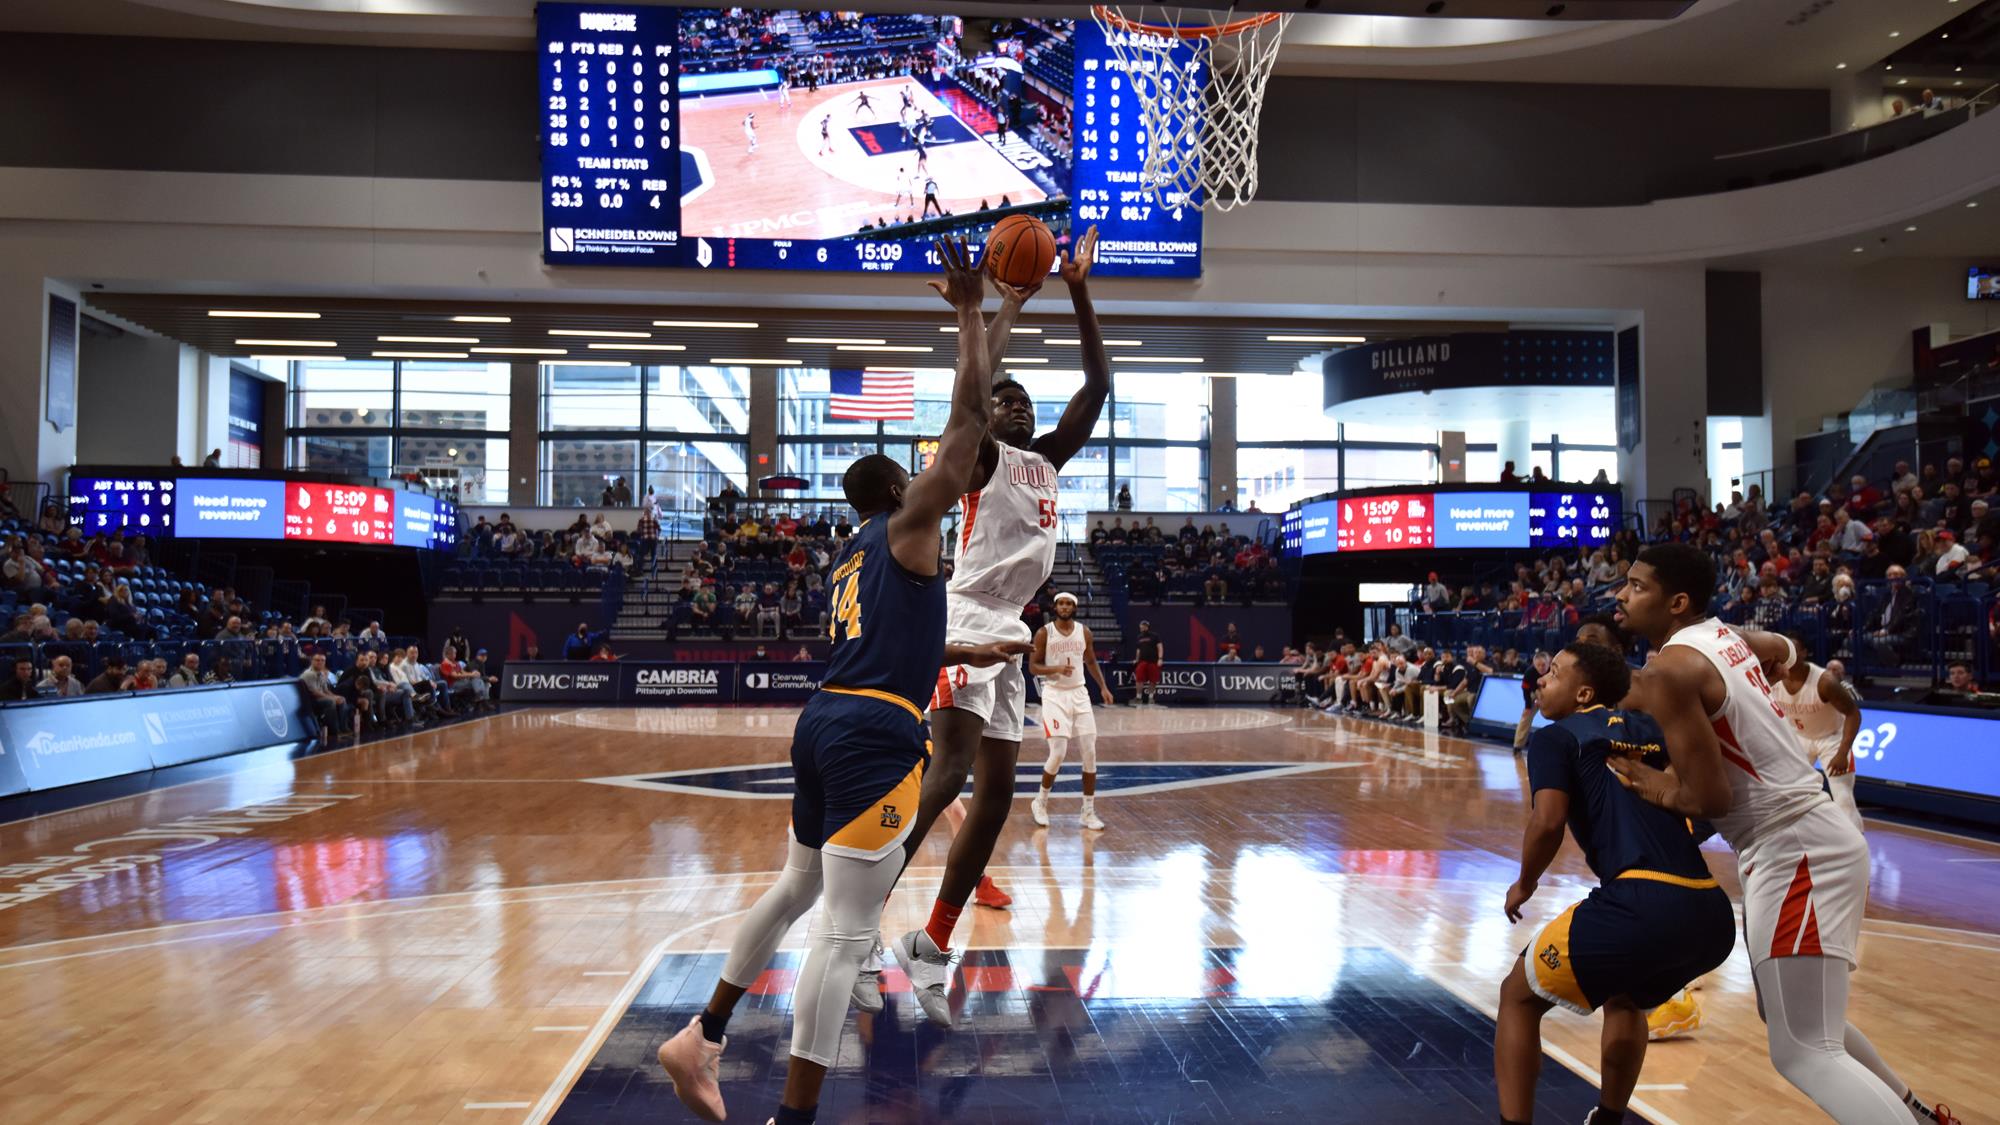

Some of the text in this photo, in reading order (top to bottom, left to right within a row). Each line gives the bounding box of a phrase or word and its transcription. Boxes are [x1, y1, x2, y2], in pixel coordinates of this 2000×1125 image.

[1105, 32, 1127, 47] LA
[571, 42, 595, 55] PTS
[598, 43, 624, 55] REB
[632, 44, 643, 56] A
[655, 45, 672, 57] PF
[553, 59, 669, 77] 1 2 0 0 0
[553, 78, 669, 95] 5 0 0 0 0
[1086, 76, 1096, 90] 2
[1111, 77, 1120, 91] 0
[549, 96, 670, 113] 23 2 1 0 0
[1085, 94, 1120, 109] 3 0
[549, 114, 670, 132] 35 0 0 0 0
[1085, 112, 1095, 125] 5
[1110, 112, 1120, 126] 5
[550, 132, 671, 150] 55 0 1 0 0
[1081, 129, 1098, 143] 14
[1109, 130, 1119, 144] 0
[1136, 131, 1146, 145] 0
[1081, 147, 1145, 162] 24 3 1
[577, 157, 649, 171] TEAM STATS
[551, 176, 582, 188] FG %
[618, 178, 630, 190] %
[1105, 171, 1138, 183] TEAM
[642, 179, 668, 191] REB
[551, 192, 583, 207] 33.3
[600, 193, 624, 209] 0.0
[650, 194, 661, 209] 4
[1080, 189, 1110, 202] FG %
[1120, 191, 1154, 203] 3PT %
[1079, 205, 1110, 220] 66.7
[1121, 206, 1152, 221] 66.7
[1172, 207, 1183, 222] 4
[575, 228, 678, 242] SCHNEIDER DOWNS
[778, 248, 787, 260] 0
[855, 242, 903, 261] 15:09
[1100, 240, 1197, 253] SCHNEIDER DOWNS
[816, 247, 828, 263] 6
[862, 261, 880, 271] PER:
[1372, 343, 1450, 370] GILLIAND
[1383, 367, 1435, 380] PAVILION
[94, 480, 113, 491] AST
[114, 481, 135, 491] BLK
[160, 481, 174, 491] TO
[99, 493, 107, 506] 1
[121, 493, 129, 506] 1
[142, 493, 150, 506] 1
[161, 493, 171, 506] 0
[193, 494, 267, 508] Need more
[325, 489, 367, 507] 15:09
[199, 509, 261, 521] revenue?
[1039, 498, 1058, 529] 55
[1362, 500, 1400, 517] 15:09
[1450, 507, 1515, 519] Need more
[1557, 506, 1578, 519] 0-0
[140, 513, 150, 527] 0
[162, 514, 170, 527] 1
[287, 515, 303, 524] TOL
[325, 519, 337, 534] 6
[1455, 519, 1509, 532] revenue?
[352, 520, 369, 536] 10
[1385, 528, 1403, 543] 10
[1407, 525, 1422, 534] TOL
[1363, 529, 1373, 544] 6
[829, 571, 863, 645] 14
[512, 674, 571, 689] UPMC
[772, 673, 808, 682] Clearway
[1220, 675, 1275, 691] UPMC
[636, 687, 718, 696] Pittsburgh Downtown
[772, 681, 817, 690] Community
